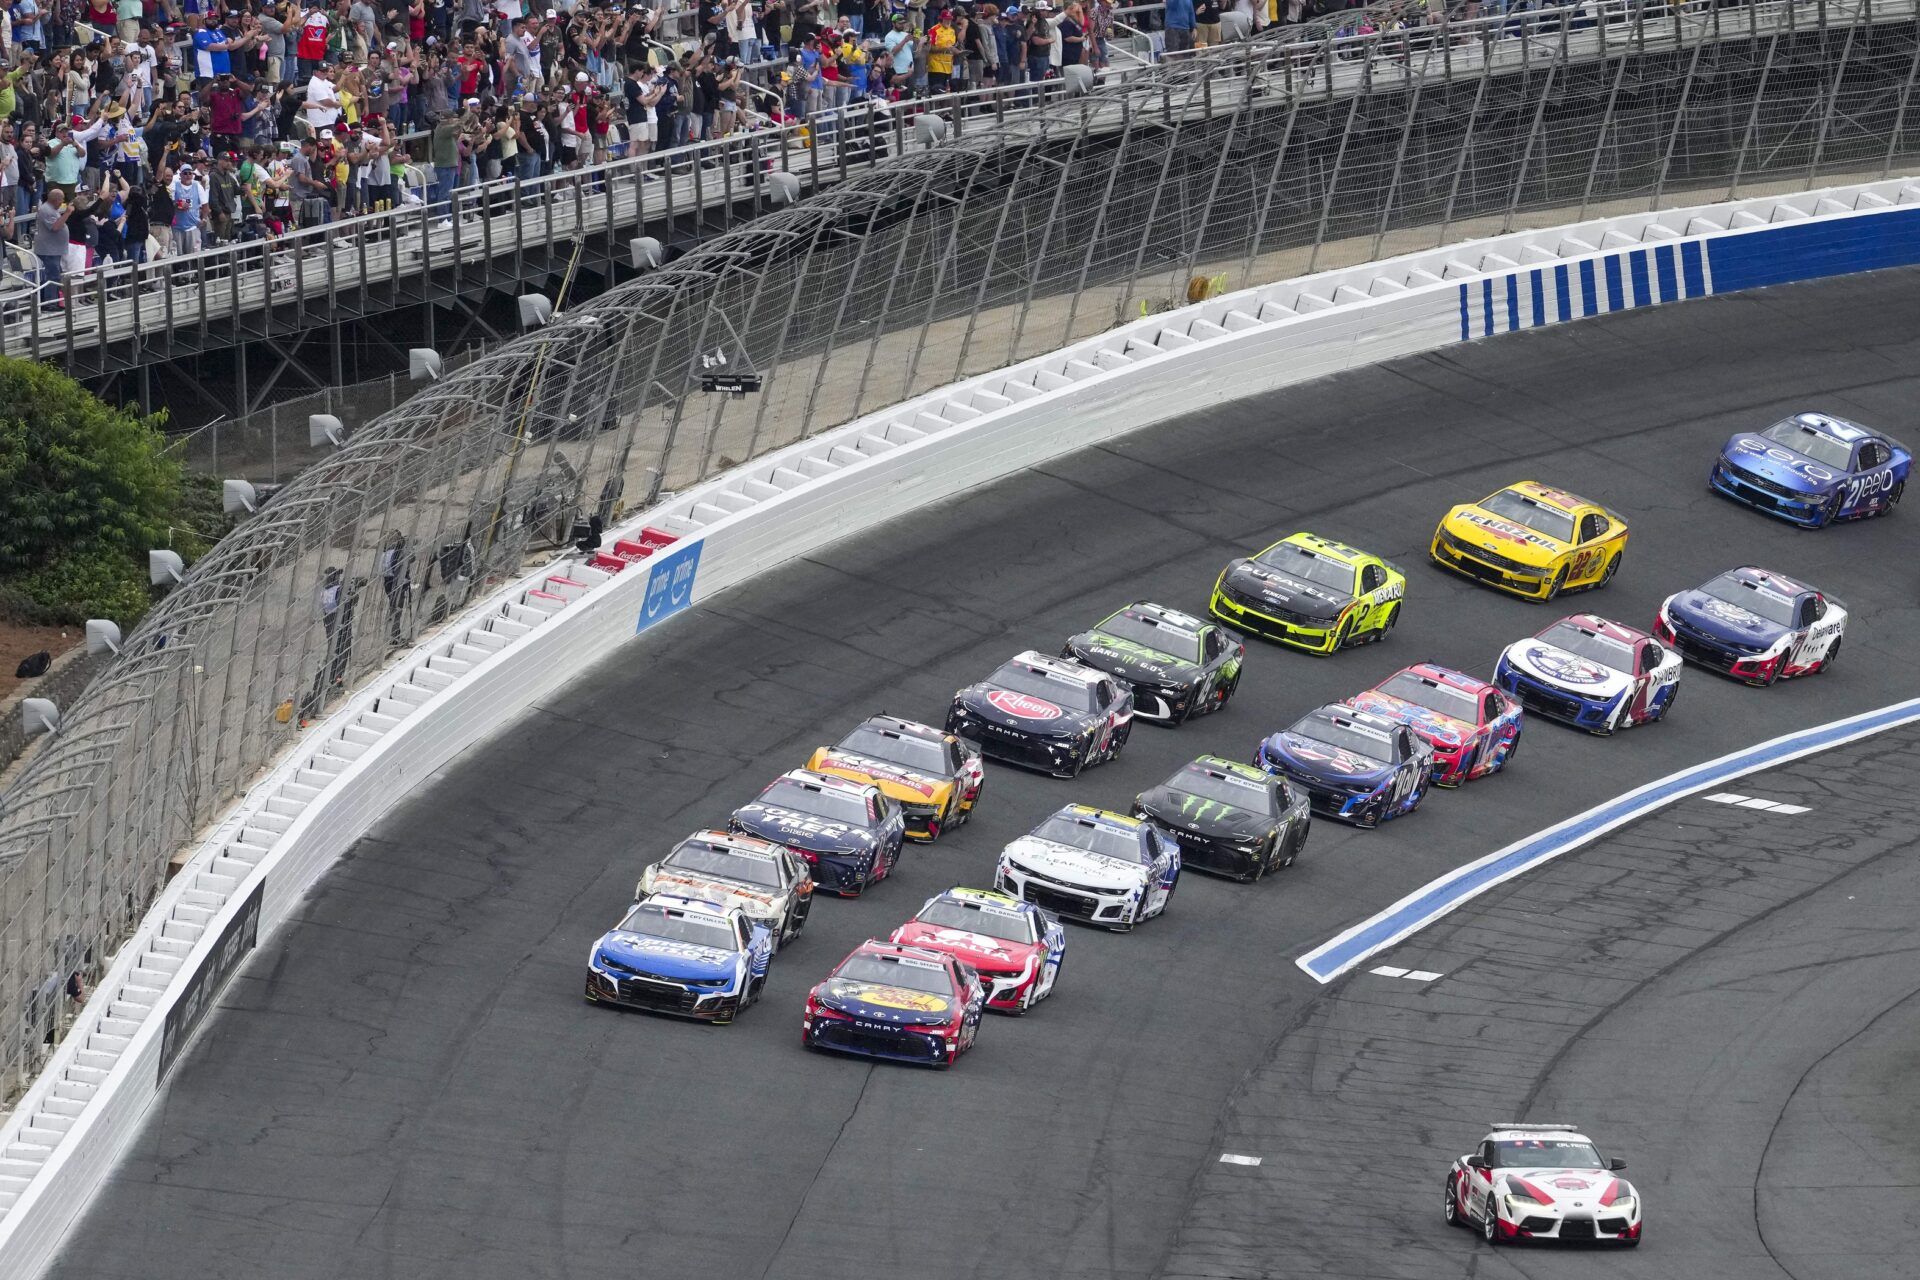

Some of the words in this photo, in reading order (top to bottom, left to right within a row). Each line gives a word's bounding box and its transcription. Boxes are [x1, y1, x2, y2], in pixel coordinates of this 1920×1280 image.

[1739, 438, 1832, 480] eero
[1783, 464, 1806, 480] should
[1807, 476, 1818, 485] be
[1455, 512, 1561, 553] PENNZOIL
[1237, 565, 1341, 606] DURACELL
[1812, 622, 1841, 641] Delaware
[1090, 646, 1119, 658] HARD
[997, 690, 1056, 719] Rheem
[988, 725, 1029, 740] CAMRY
[832, 760, 871, 775] TRUCK
[872, 769, 922, 789] CENTERS
[739, 804, 873, 841] DOLLAR
[761, 814, 846, 839] TREE
[1170, 828, 1211, 844] CAMRY
[912, 935, 1011, 962] AXALTA
[855, 1021, 902, 1032] CAMRY
